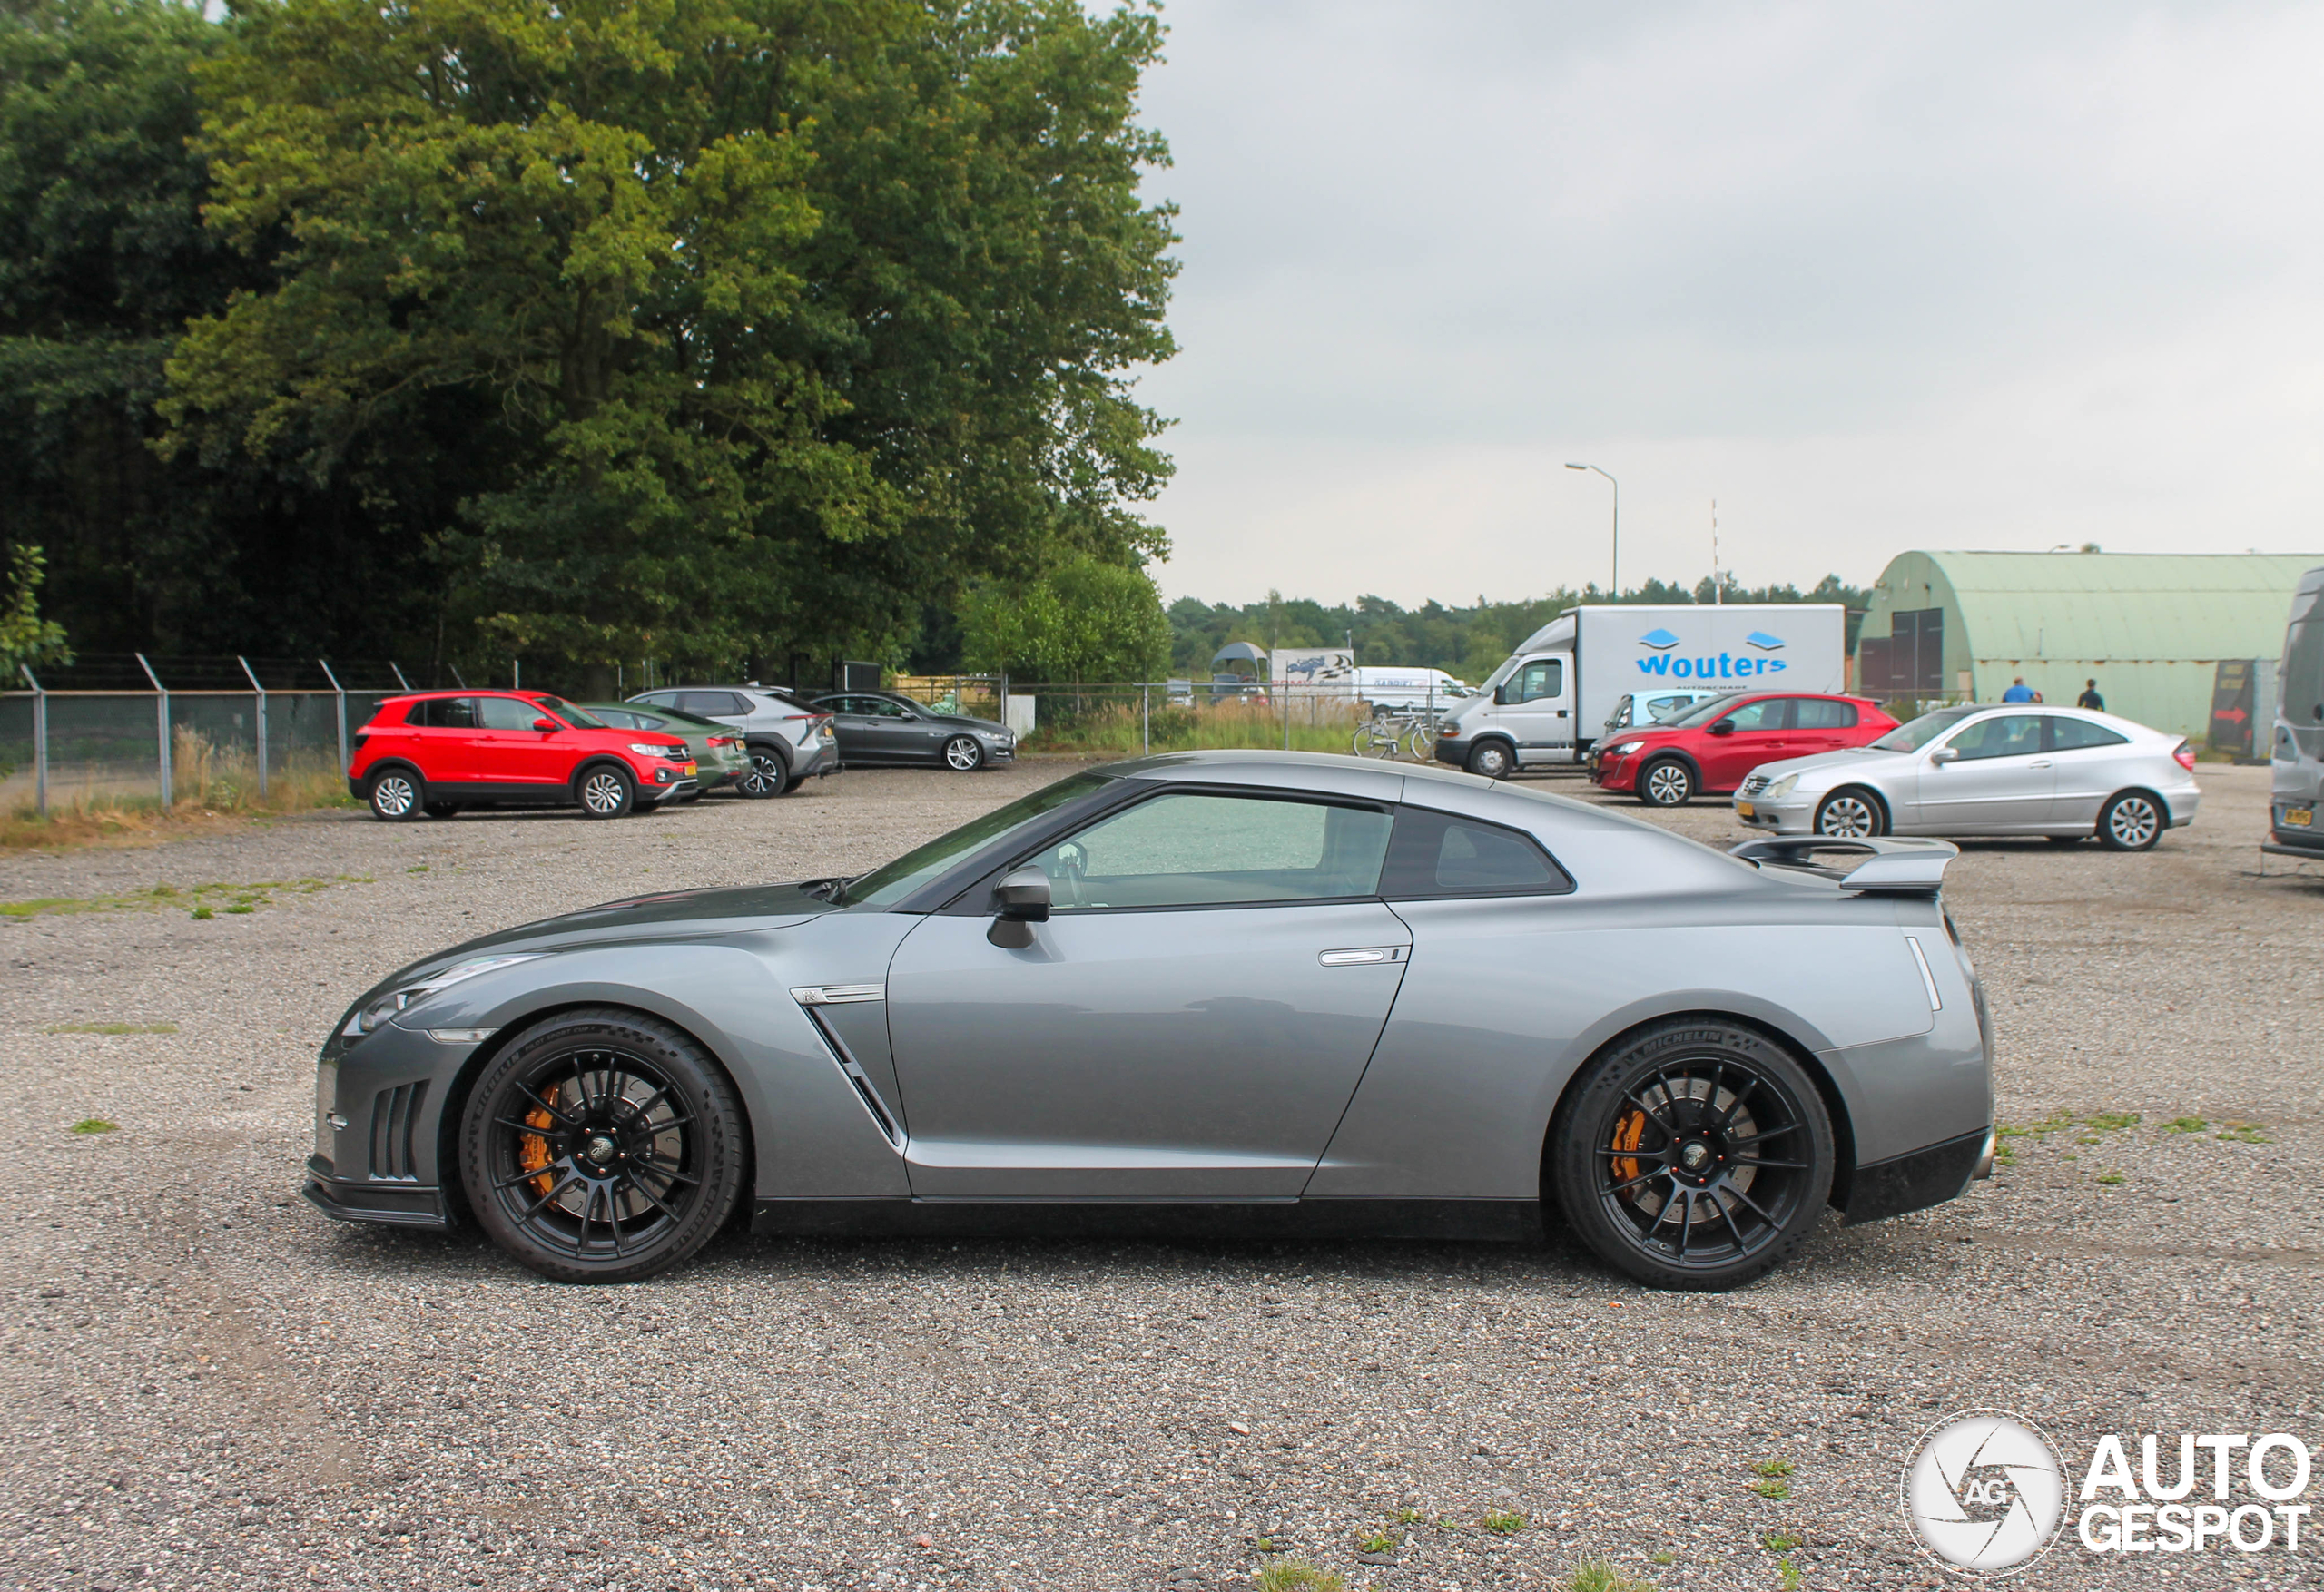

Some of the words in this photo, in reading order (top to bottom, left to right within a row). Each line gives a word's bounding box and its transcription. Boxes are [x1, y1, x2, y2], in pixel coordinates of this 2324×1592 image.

[1636, 652, 1787, 678] Wouters
[1643, 1031, 1722, 1055] MICHELIN
[477, 1050, 521, 1117] MICHELIN
[547, 1028, 571, 1041] SPORT
